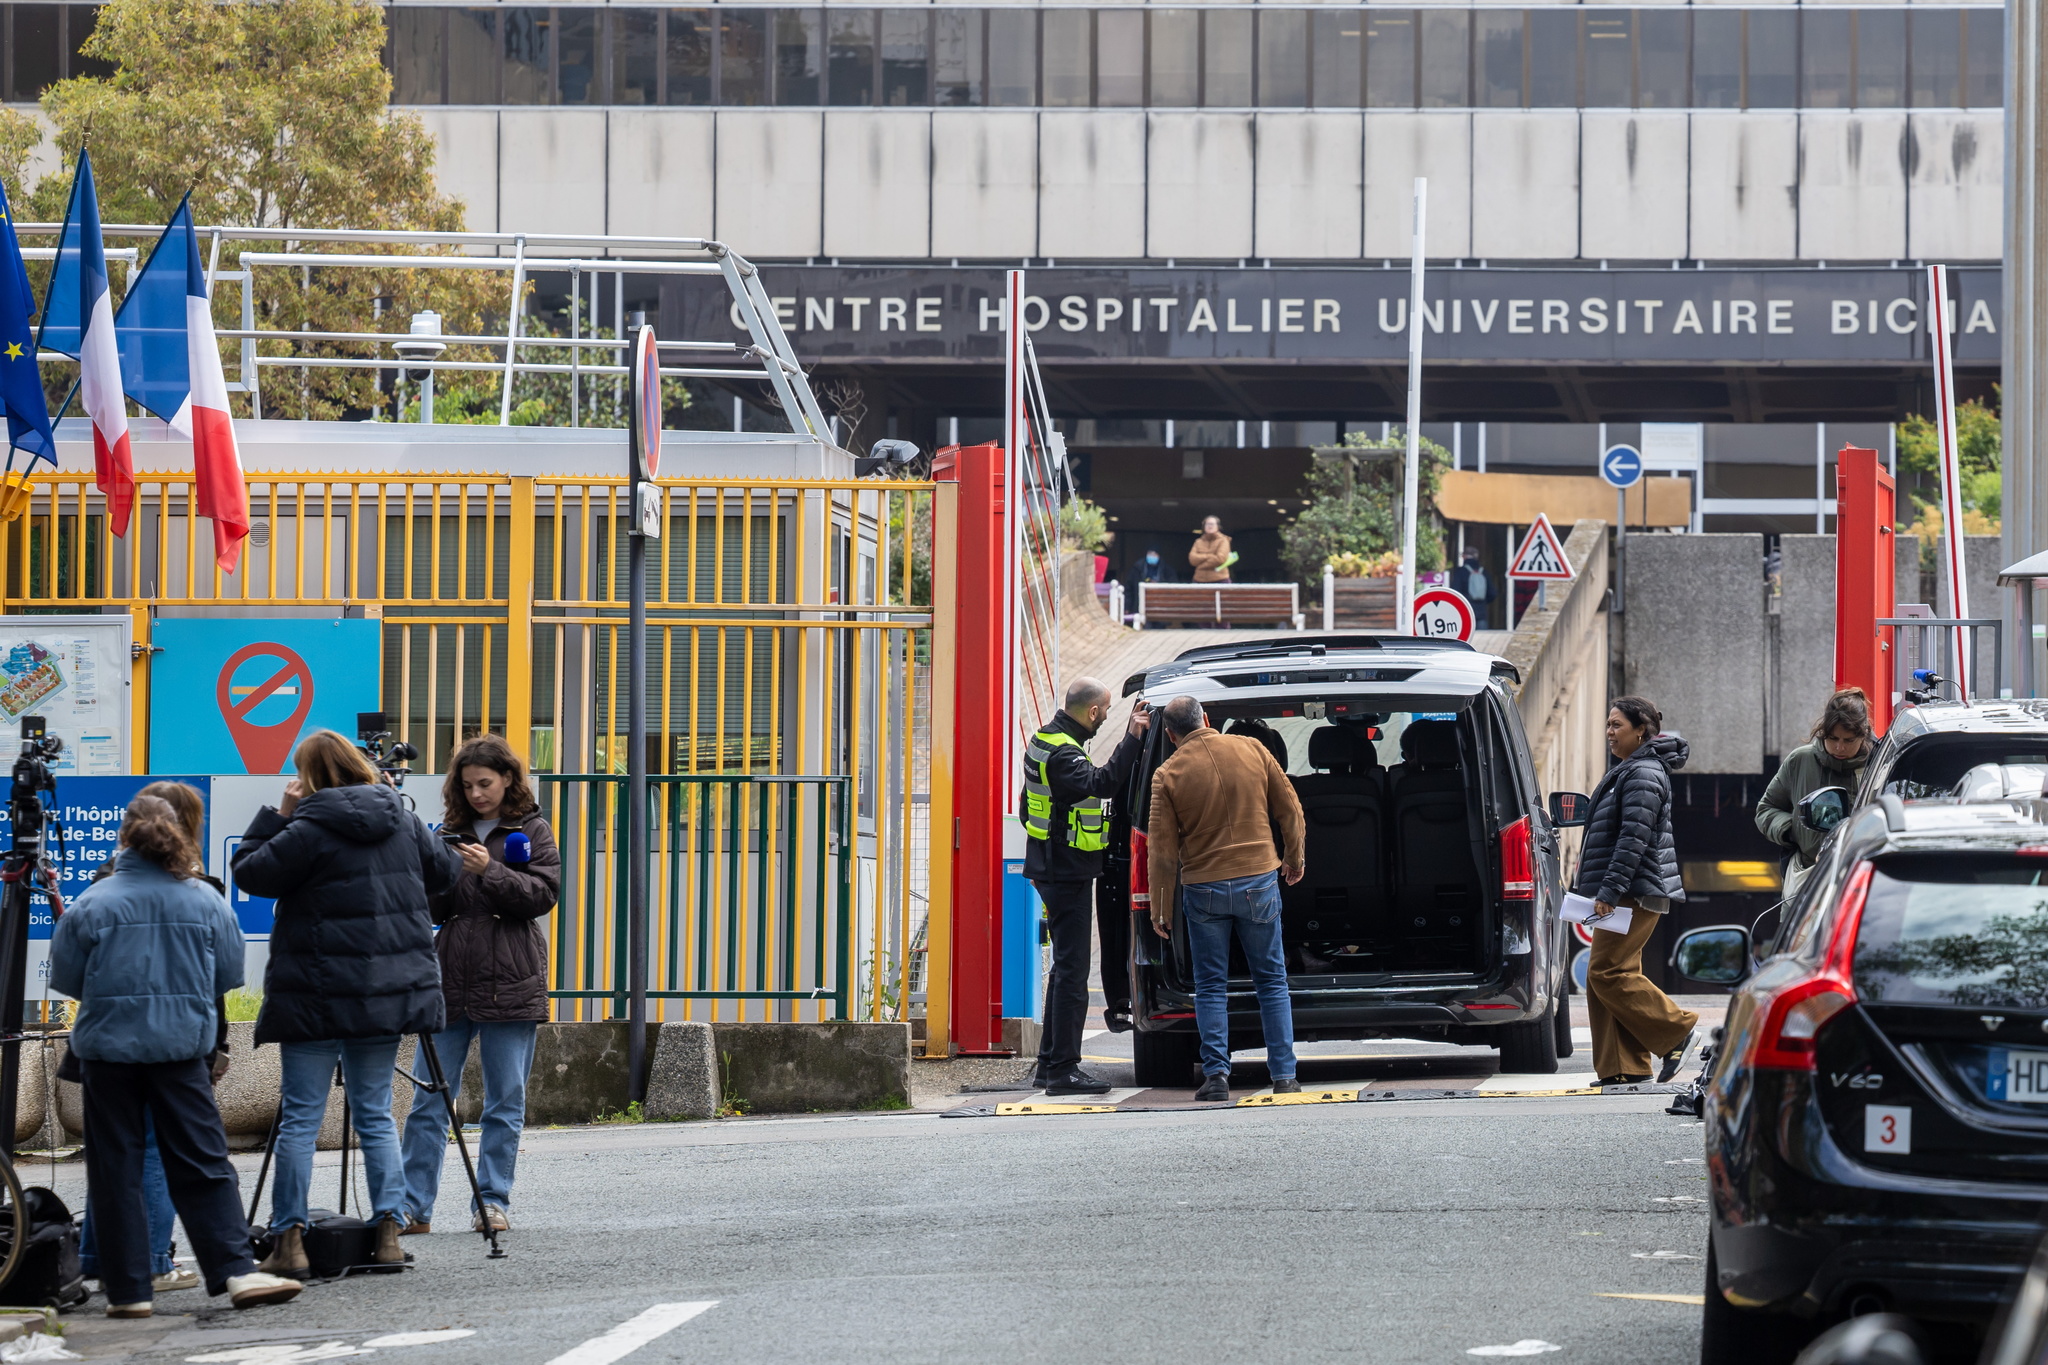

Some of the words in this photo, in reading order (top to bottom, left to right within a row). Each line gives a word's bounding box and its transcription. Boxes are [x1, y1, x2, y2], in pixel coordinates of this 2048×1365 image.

[979, 295, 1341, 333] HOSPITALIER
[1378, 298, 1794, 335] UNIVERSITAIRE
[80, 846, 107, 862] les
[1830, 1072, 1884, 1089] V60
[1880, 1114, 1897, 1145] 3
